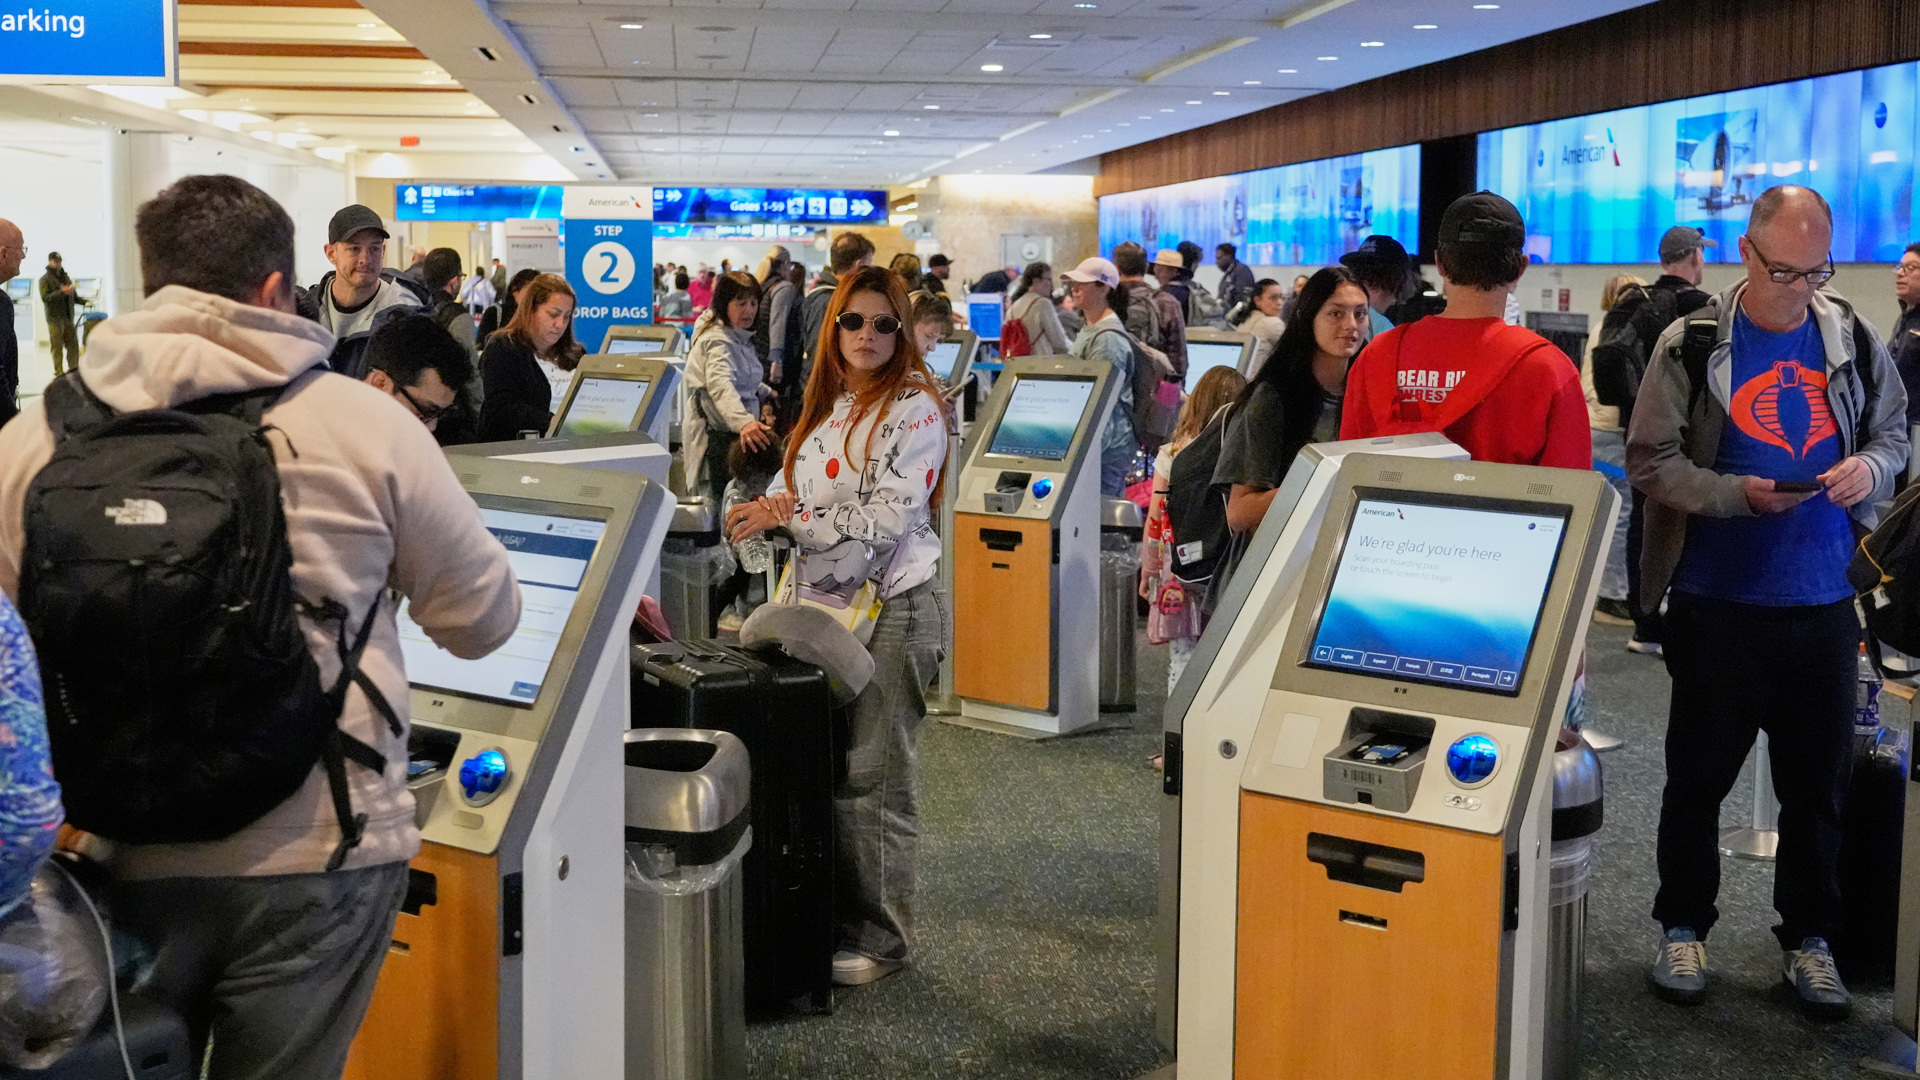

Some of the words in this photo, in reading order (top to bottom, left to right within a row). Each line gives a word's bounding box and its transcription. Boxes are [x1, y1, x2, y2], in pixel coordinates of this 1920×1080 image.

[1, 8, 85, 38] arking
[1561, 145, 1605, 166] American
[588, 198, 629, 206] American
[730, 201, 760, 211] Gates
[594, 225, 623, 236] STEP
[599, 251, 620, 283] 2
[573, 306, 609, 319] DROP
[612, 306, 648, 319] BAGS
[1397, 369, 1440, 387] BEAR
[1445, 370, 1467, 388] RI
[1361, 507, 1396, 517] American
[1359, 535, 1395, 550] We're
[1395, 540, 1426, 555] glad
[1425, 545, 1468, 558] you're
[1470, 546, 1503, 561] here
[1354, 553, 1371, 562] Scan
[1372, 557, 1389, 566] your
[1390, 557, 1422, 570] boarding
[1423, 562, 1440, 572] pass
[1360, 564, 1384, 574] touch
[1383, 567, 1395, 575] the
[1421, 572, 1430, 580] to
[1431, 573, 1453, 583] begin
